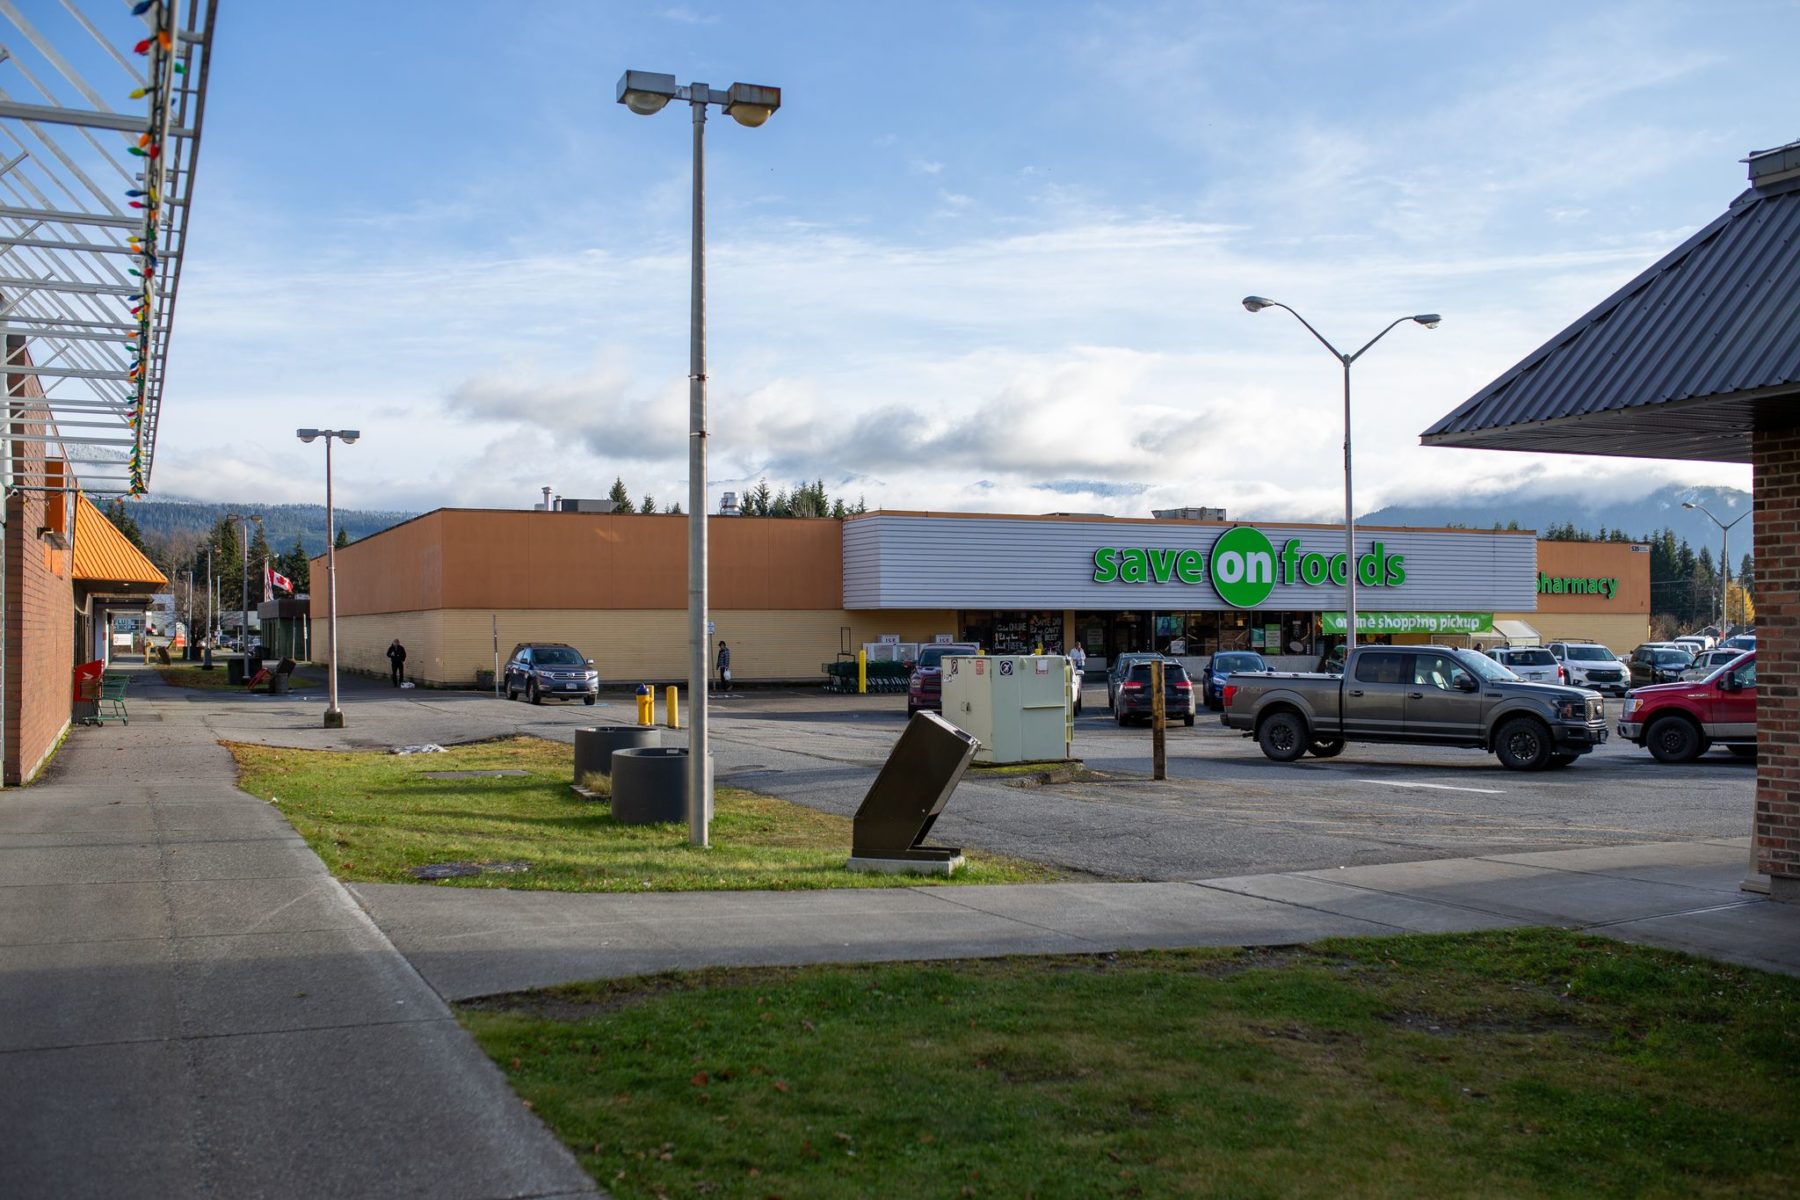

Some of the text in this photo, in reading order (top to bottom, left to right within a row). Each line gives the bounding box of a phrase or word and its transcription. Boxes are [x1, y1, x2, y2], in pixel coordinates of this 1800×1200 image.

[1094, 539, 1406, 586] save on foods
[1378, 614, 1437, 631] shopping
[1440, 614, 1480, 631] pickup
